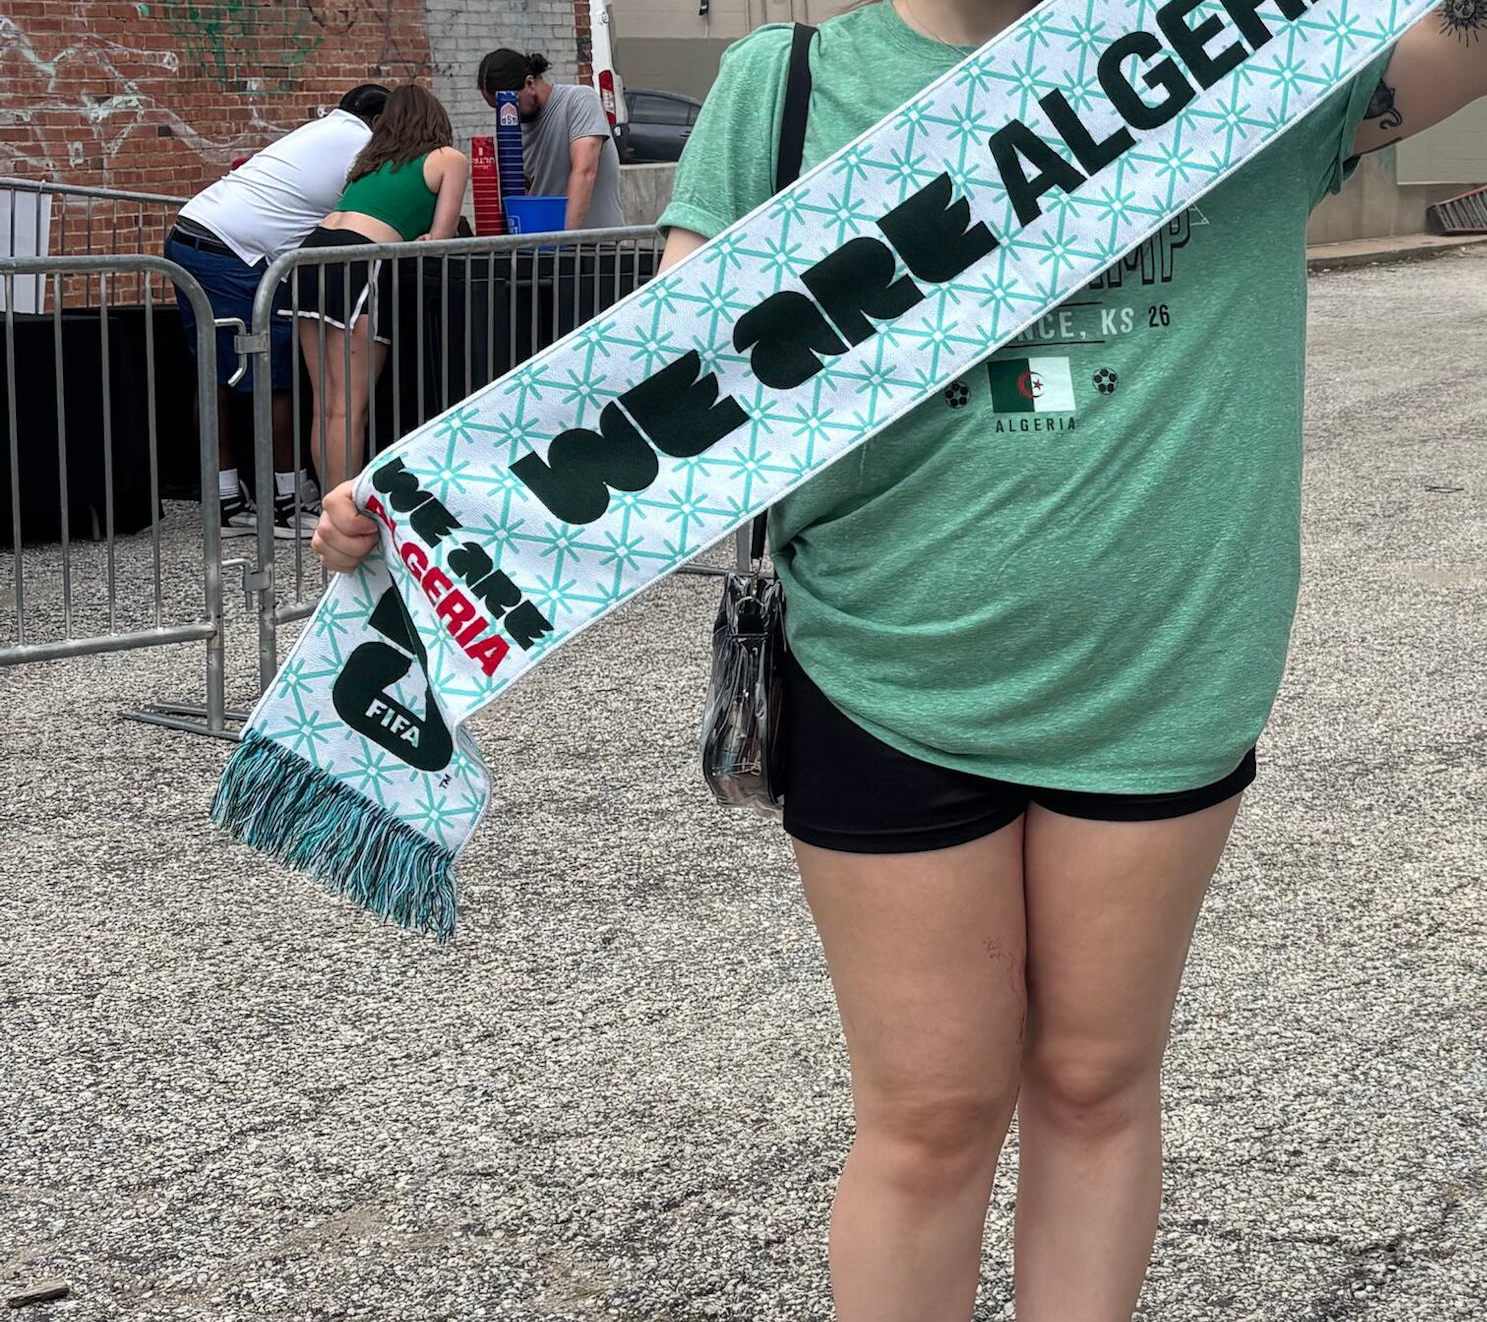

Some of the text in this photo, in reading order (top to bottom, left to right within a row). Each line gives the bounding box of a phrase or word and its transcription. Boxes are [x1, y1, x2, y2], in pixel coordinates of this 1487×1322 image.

[1101, 307, 1134, 335] KS
[1148, 304, 1171, 327] 26
[508, 350, 751, 525] WE
[995, 417, 1077, 433] ALGERIA
[372, 456, 464, 549] WE
[364, 697, 422, 749] FIFA
